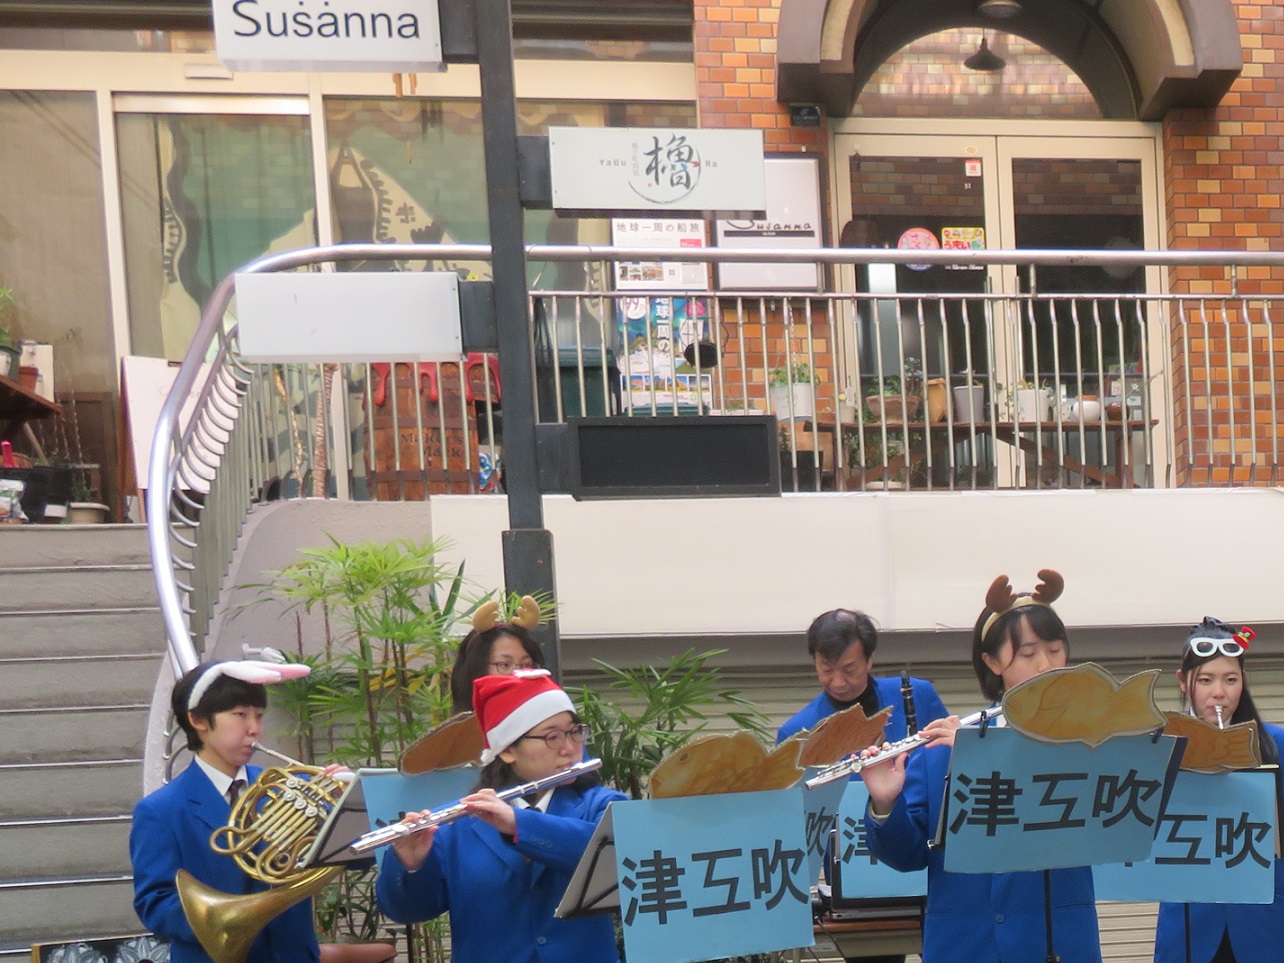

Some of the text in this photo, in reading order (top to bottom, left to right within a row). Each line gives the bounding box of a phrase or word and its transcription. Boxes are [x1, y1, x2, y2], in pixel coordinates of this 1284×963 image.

[233, 0, 420, 38] Susanna
[599, 159, 627, 167] YaGu
[616, 222, 700, 233] 地球一周の船旅
